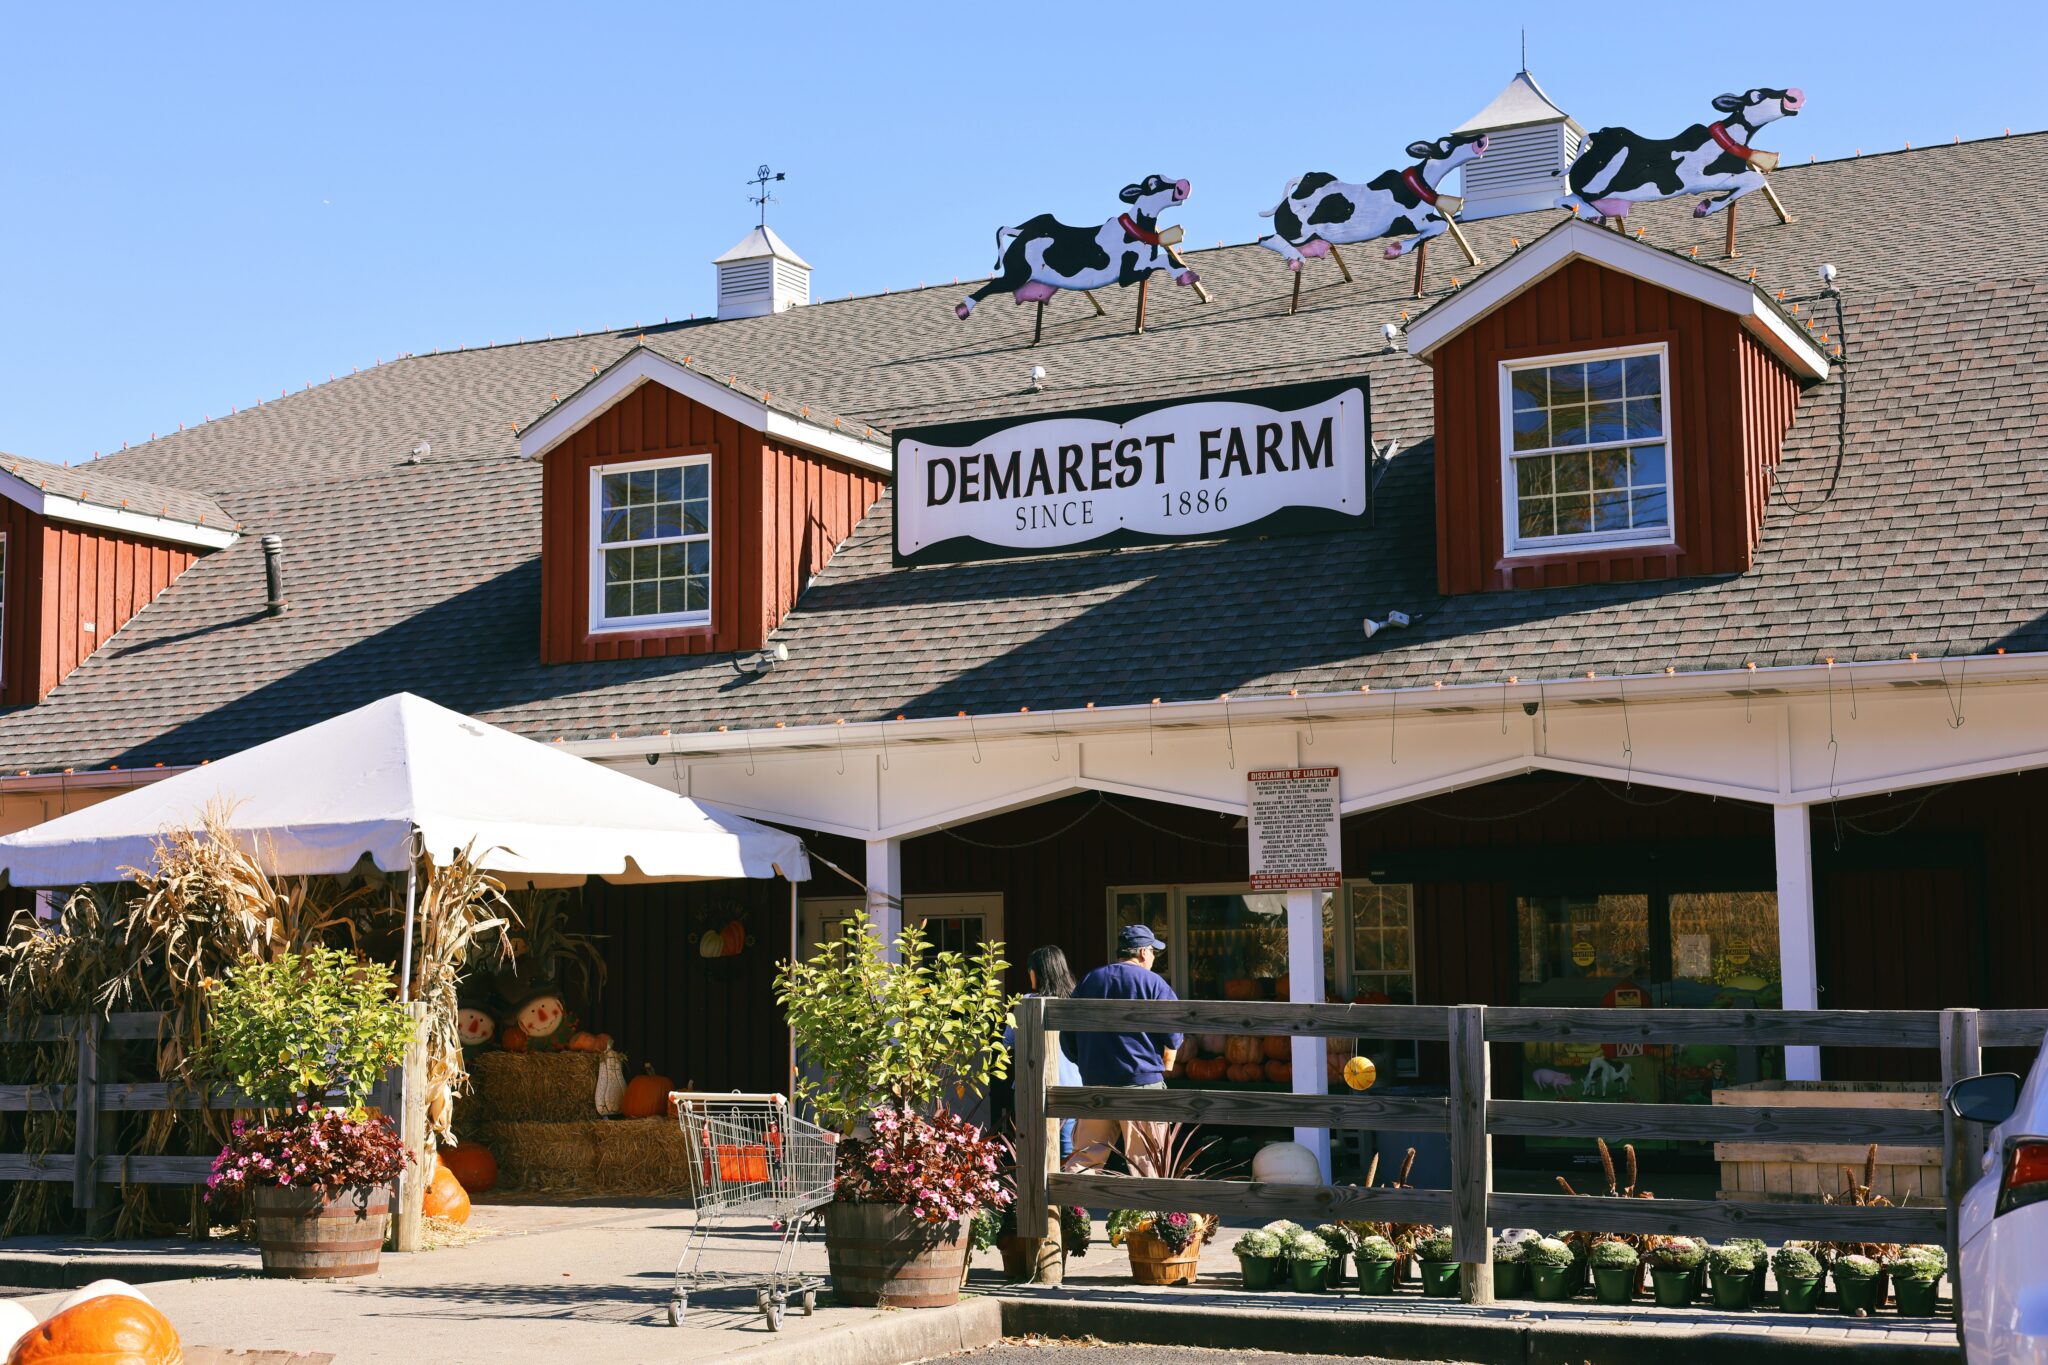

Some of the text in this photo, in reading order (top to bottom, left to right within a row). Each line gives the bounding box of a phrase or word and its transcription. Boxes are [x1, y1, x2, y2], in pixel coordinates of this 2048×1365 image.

[926, 416, 1334, 507] DEMAREST FARM
[1015, 487, 1228, 531] SINCE 1886
[1251, 771, 1290, 780] DISCLAIMER
[1303, 769, 1334, 777] LIABILITY
